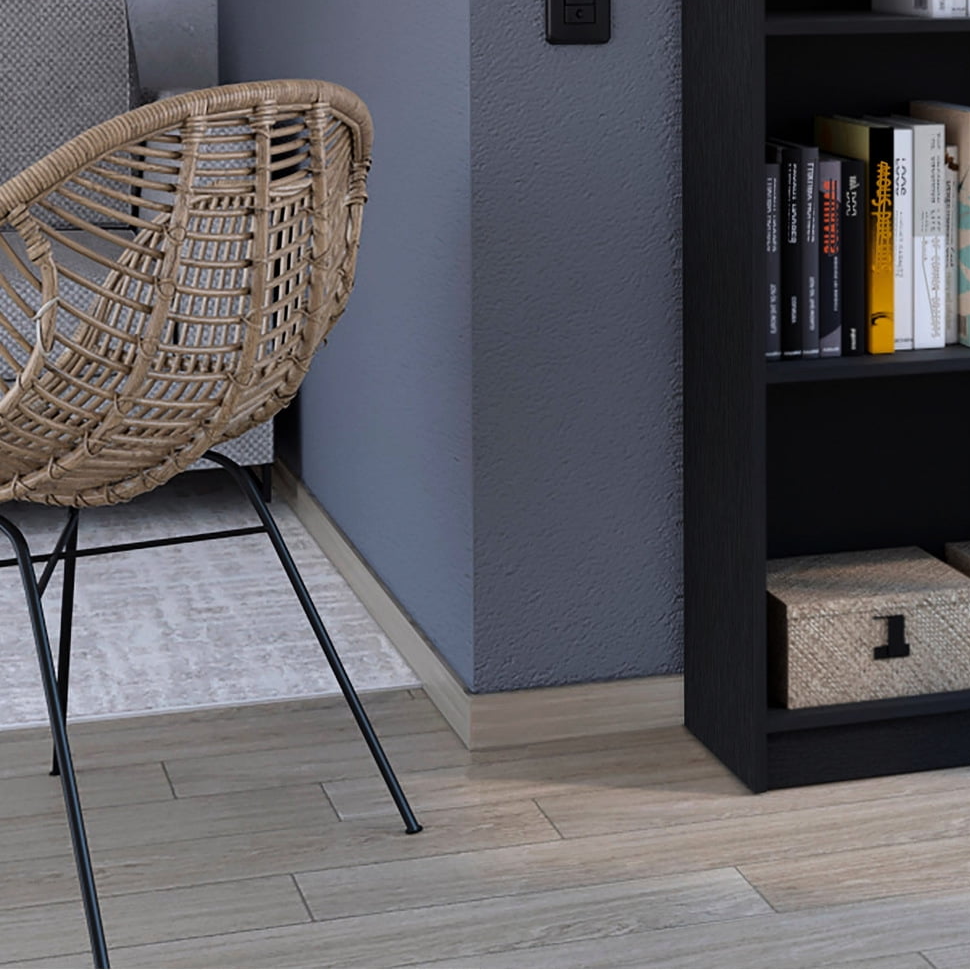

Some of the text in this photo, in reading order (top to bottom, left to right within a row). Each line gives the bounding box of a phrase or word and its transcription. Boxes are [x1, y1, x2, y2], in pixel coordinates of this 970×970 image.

[895, 157, 907, 196] LOOS
[931, 132, 942, 338] THE UNCOMMON LIFE OF COMMON OBJECTS
[873, 614, 910, 661] 1
